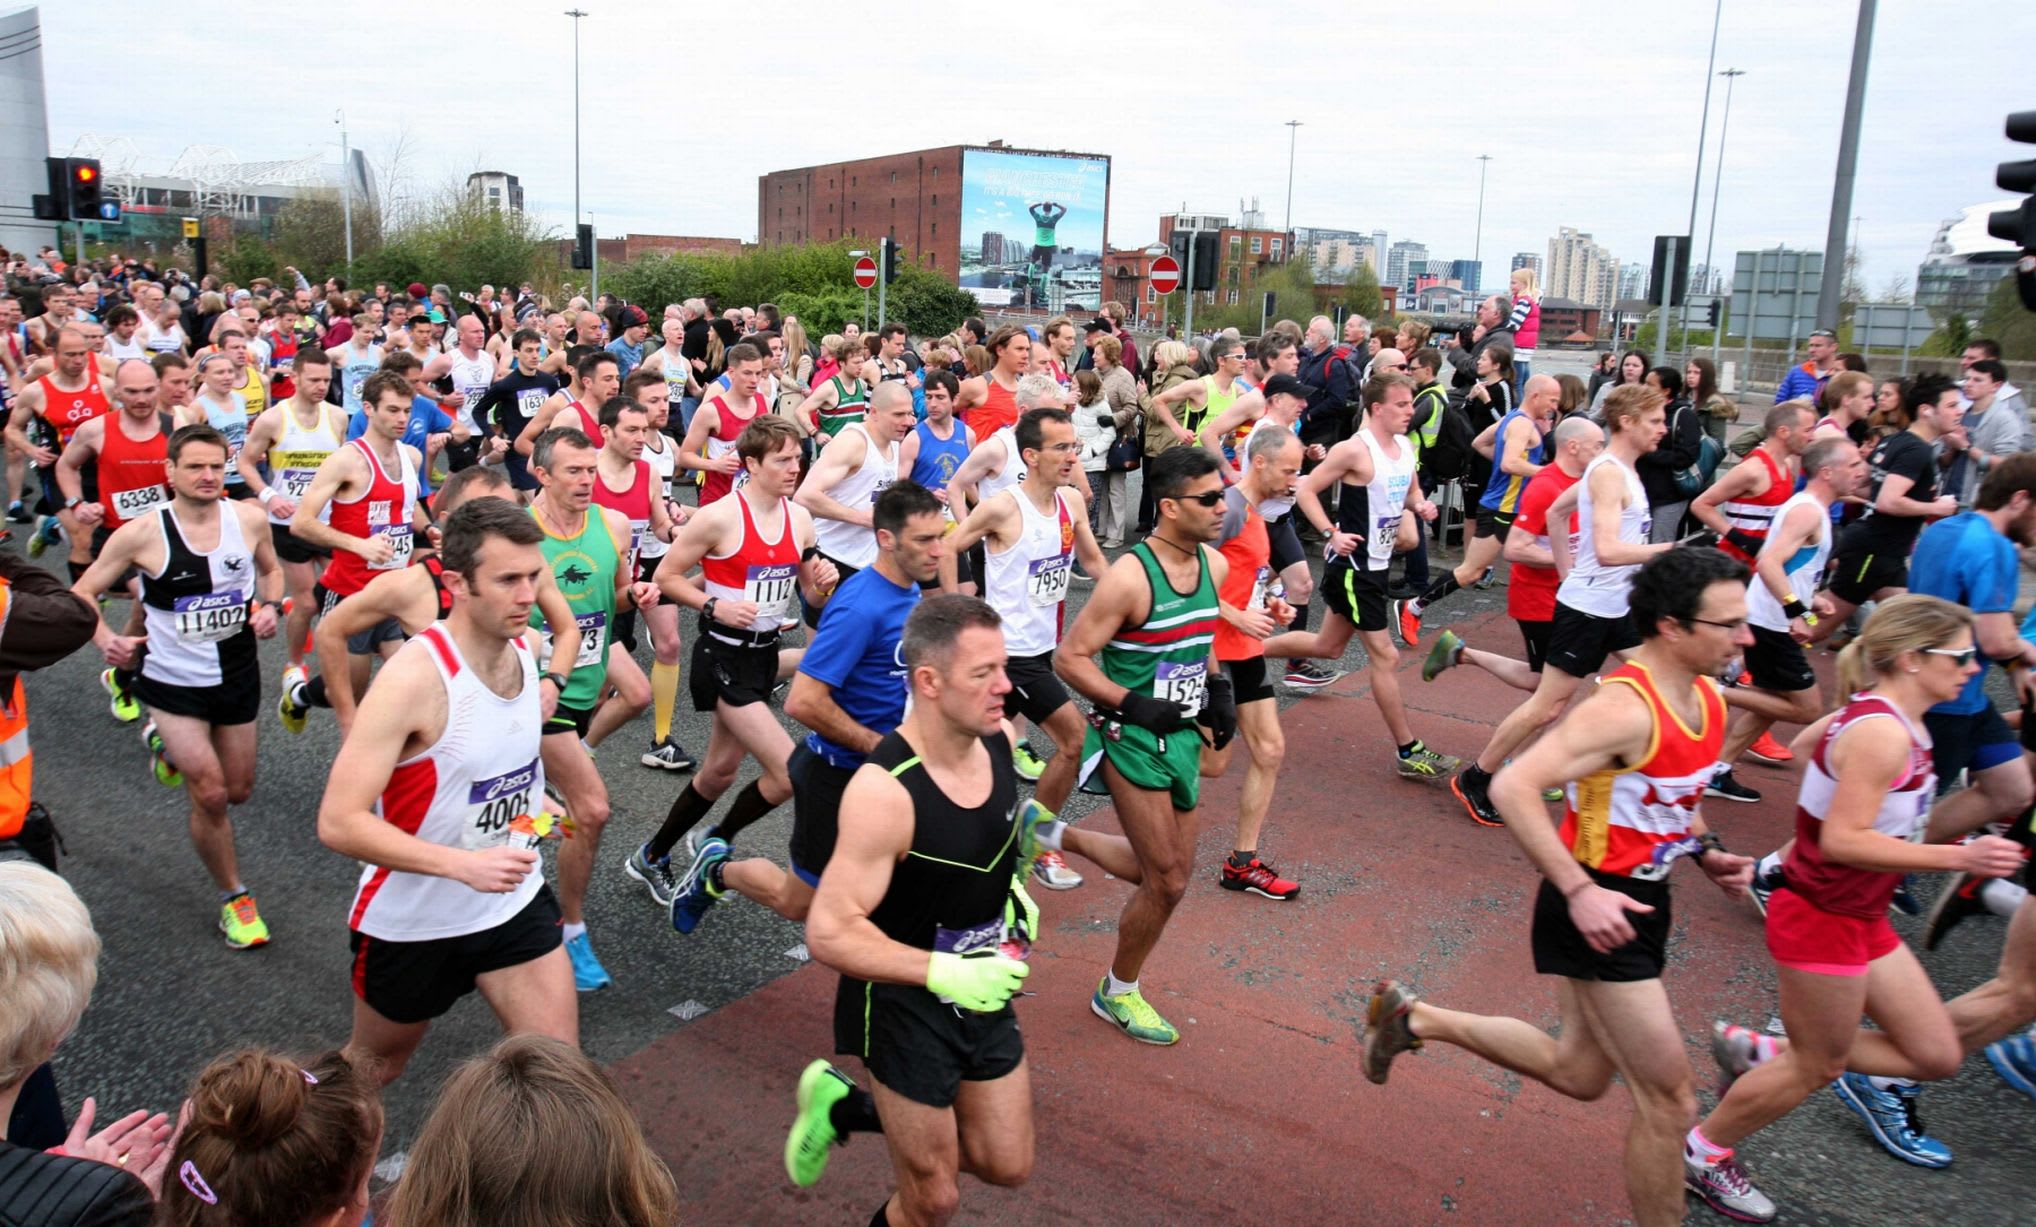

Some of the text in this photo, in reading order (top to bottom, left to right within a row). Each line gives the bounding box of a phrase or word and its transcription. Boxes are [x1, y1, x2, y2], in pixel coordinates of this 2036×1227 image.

[119, 487, 160, 509] 6338
[287, 481, 305, 497] 92
[755, 578, 791, 603] 1112
[1034, 568, 1066, 595] 7950
[200, 594, 232, 609] asics
[181, 605, 244, 634] 11402
[502, 770, 532, 791] asics
